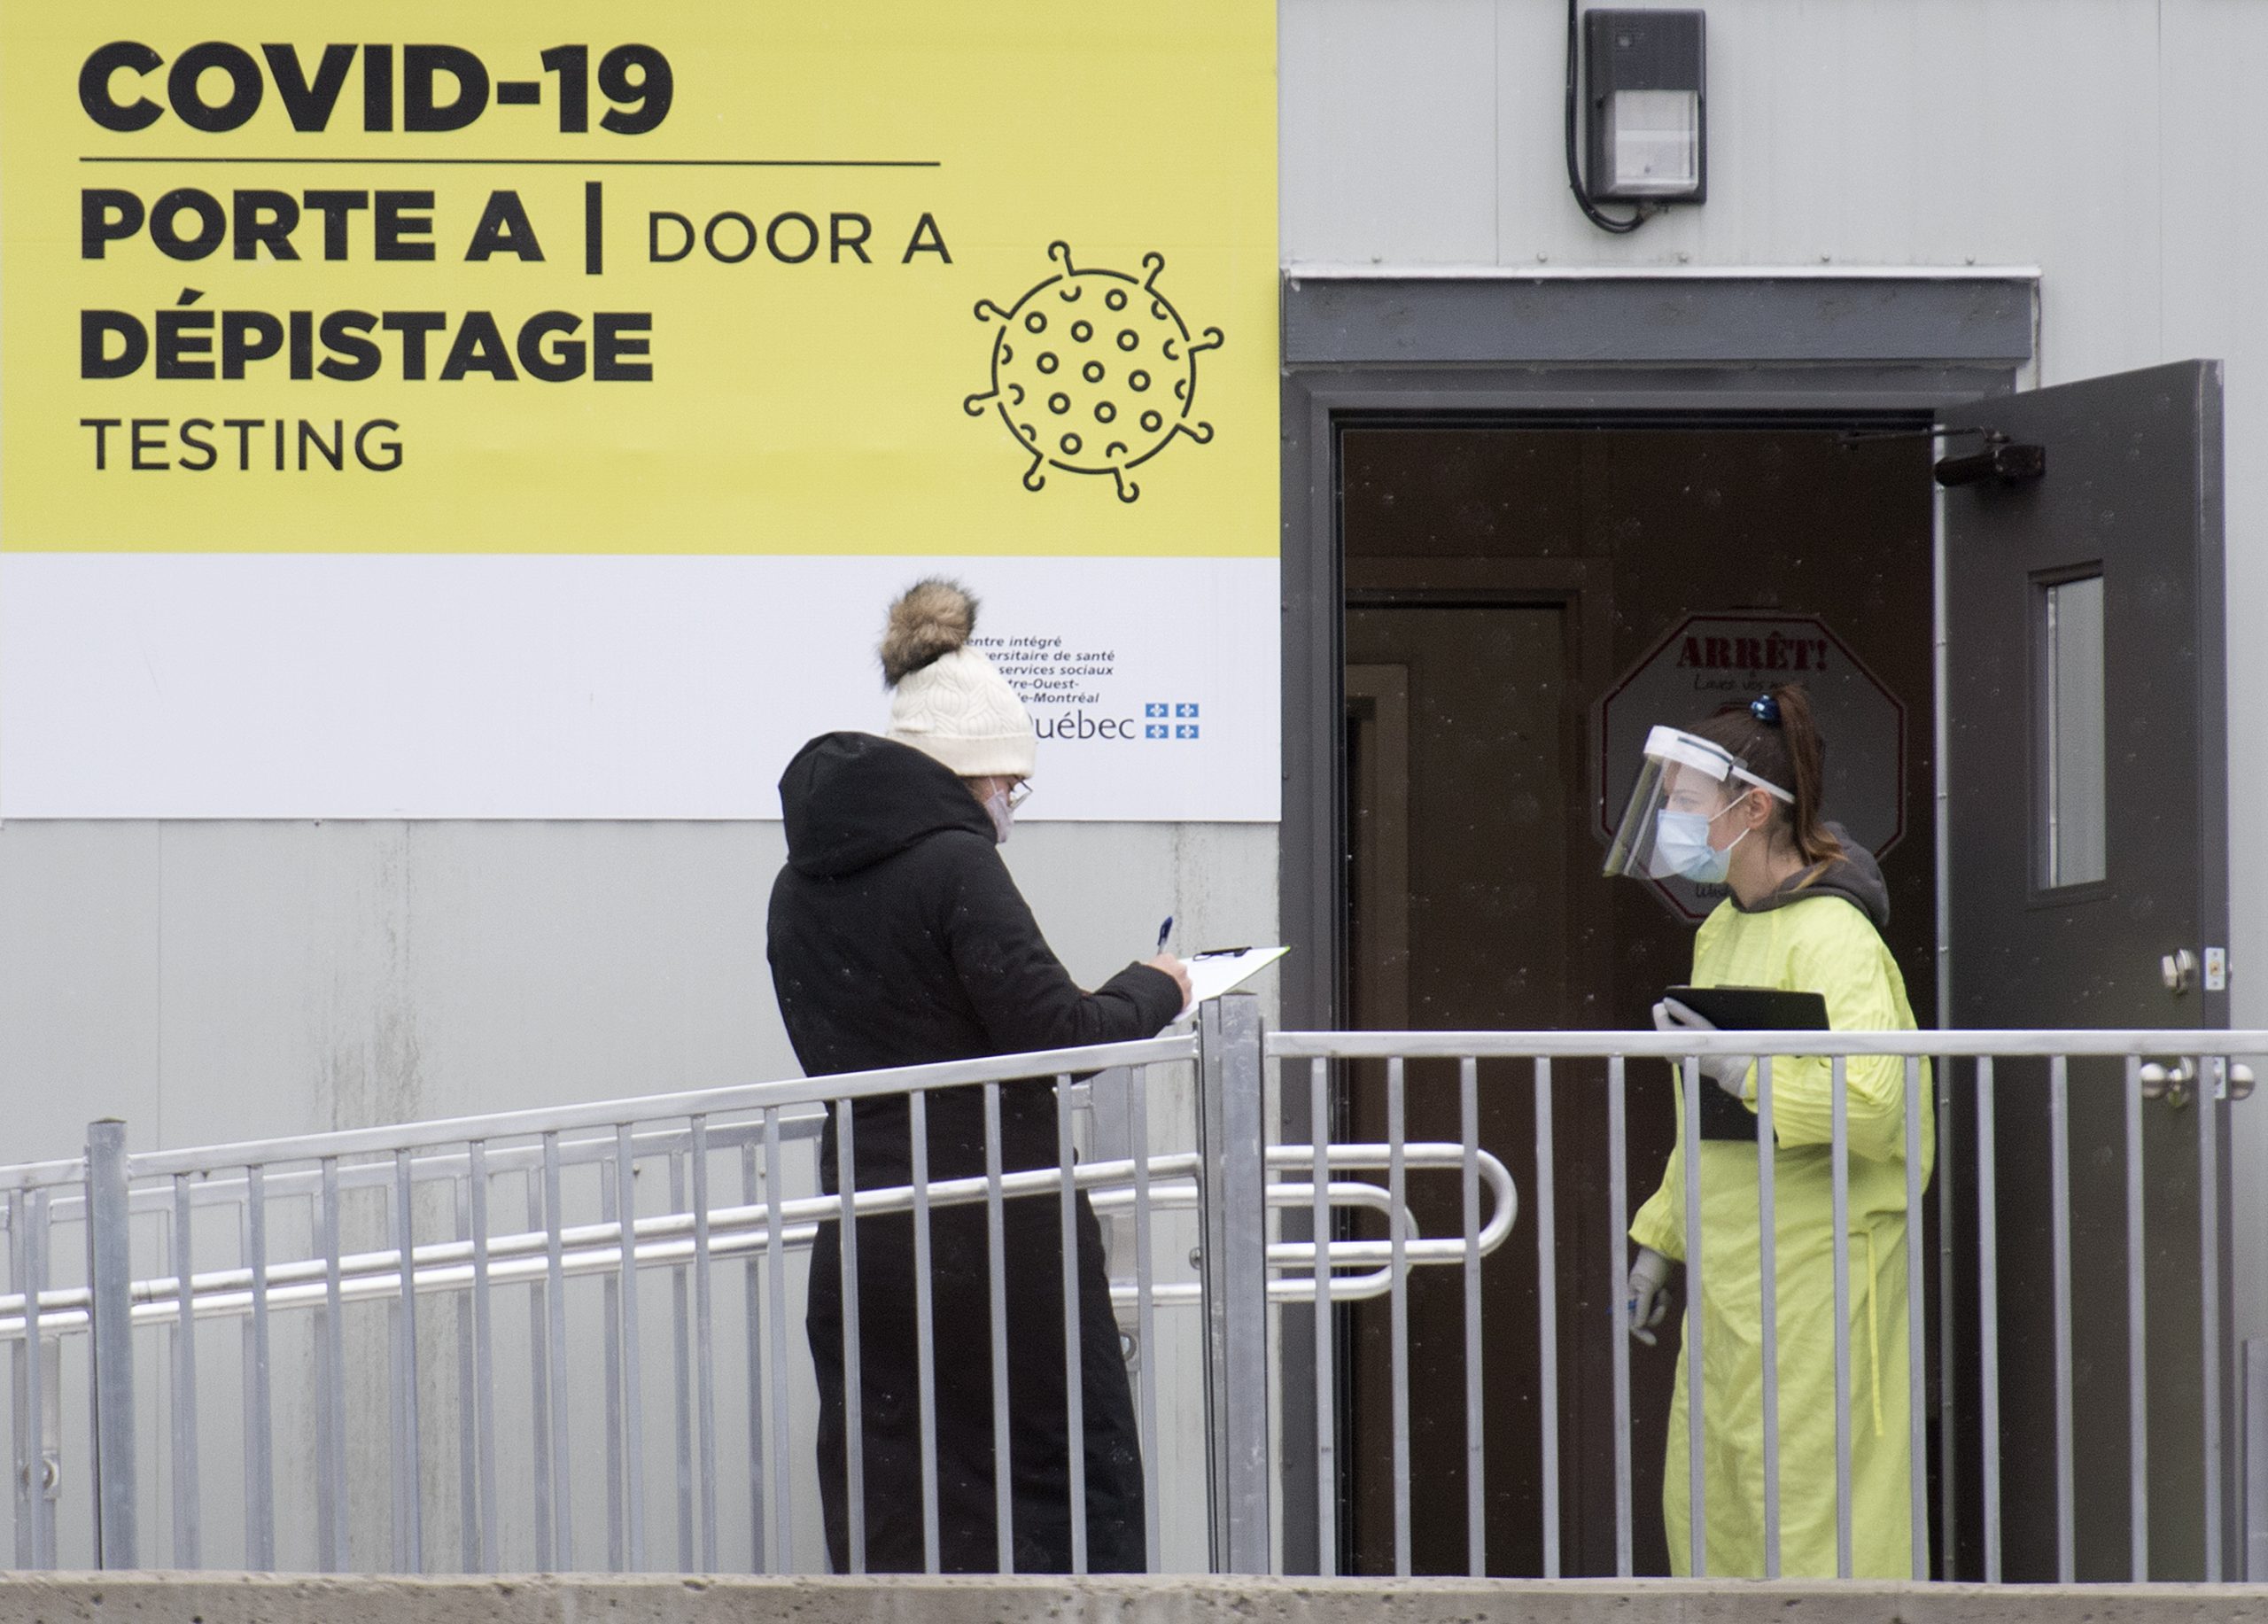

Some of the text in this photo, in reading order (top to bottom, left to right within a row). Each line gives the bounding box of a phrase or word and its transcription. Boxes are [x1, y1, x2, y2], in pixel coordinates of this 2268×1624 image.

[78, 41, 674, 135] COVID-19
[81, 187, 952, 264] PORTE A DOOR A
[81, 287, 653, 382] DÉPISTAGE
[80, 418, 403, 472] TESTING
[964, 635, 1062, 649] entre intégré
[985, 651, 1115, 661] ersitaire de santé
[1676, 630, 1829, 671] ARRÊT!
[998, 665, 1114, 675] services sociaux
[1007, 679, 1079, 689] tre-Ouest-
[1018, 692, 1099, 703] e-Montréal
[1029, 709, 1137, 740] uébec
